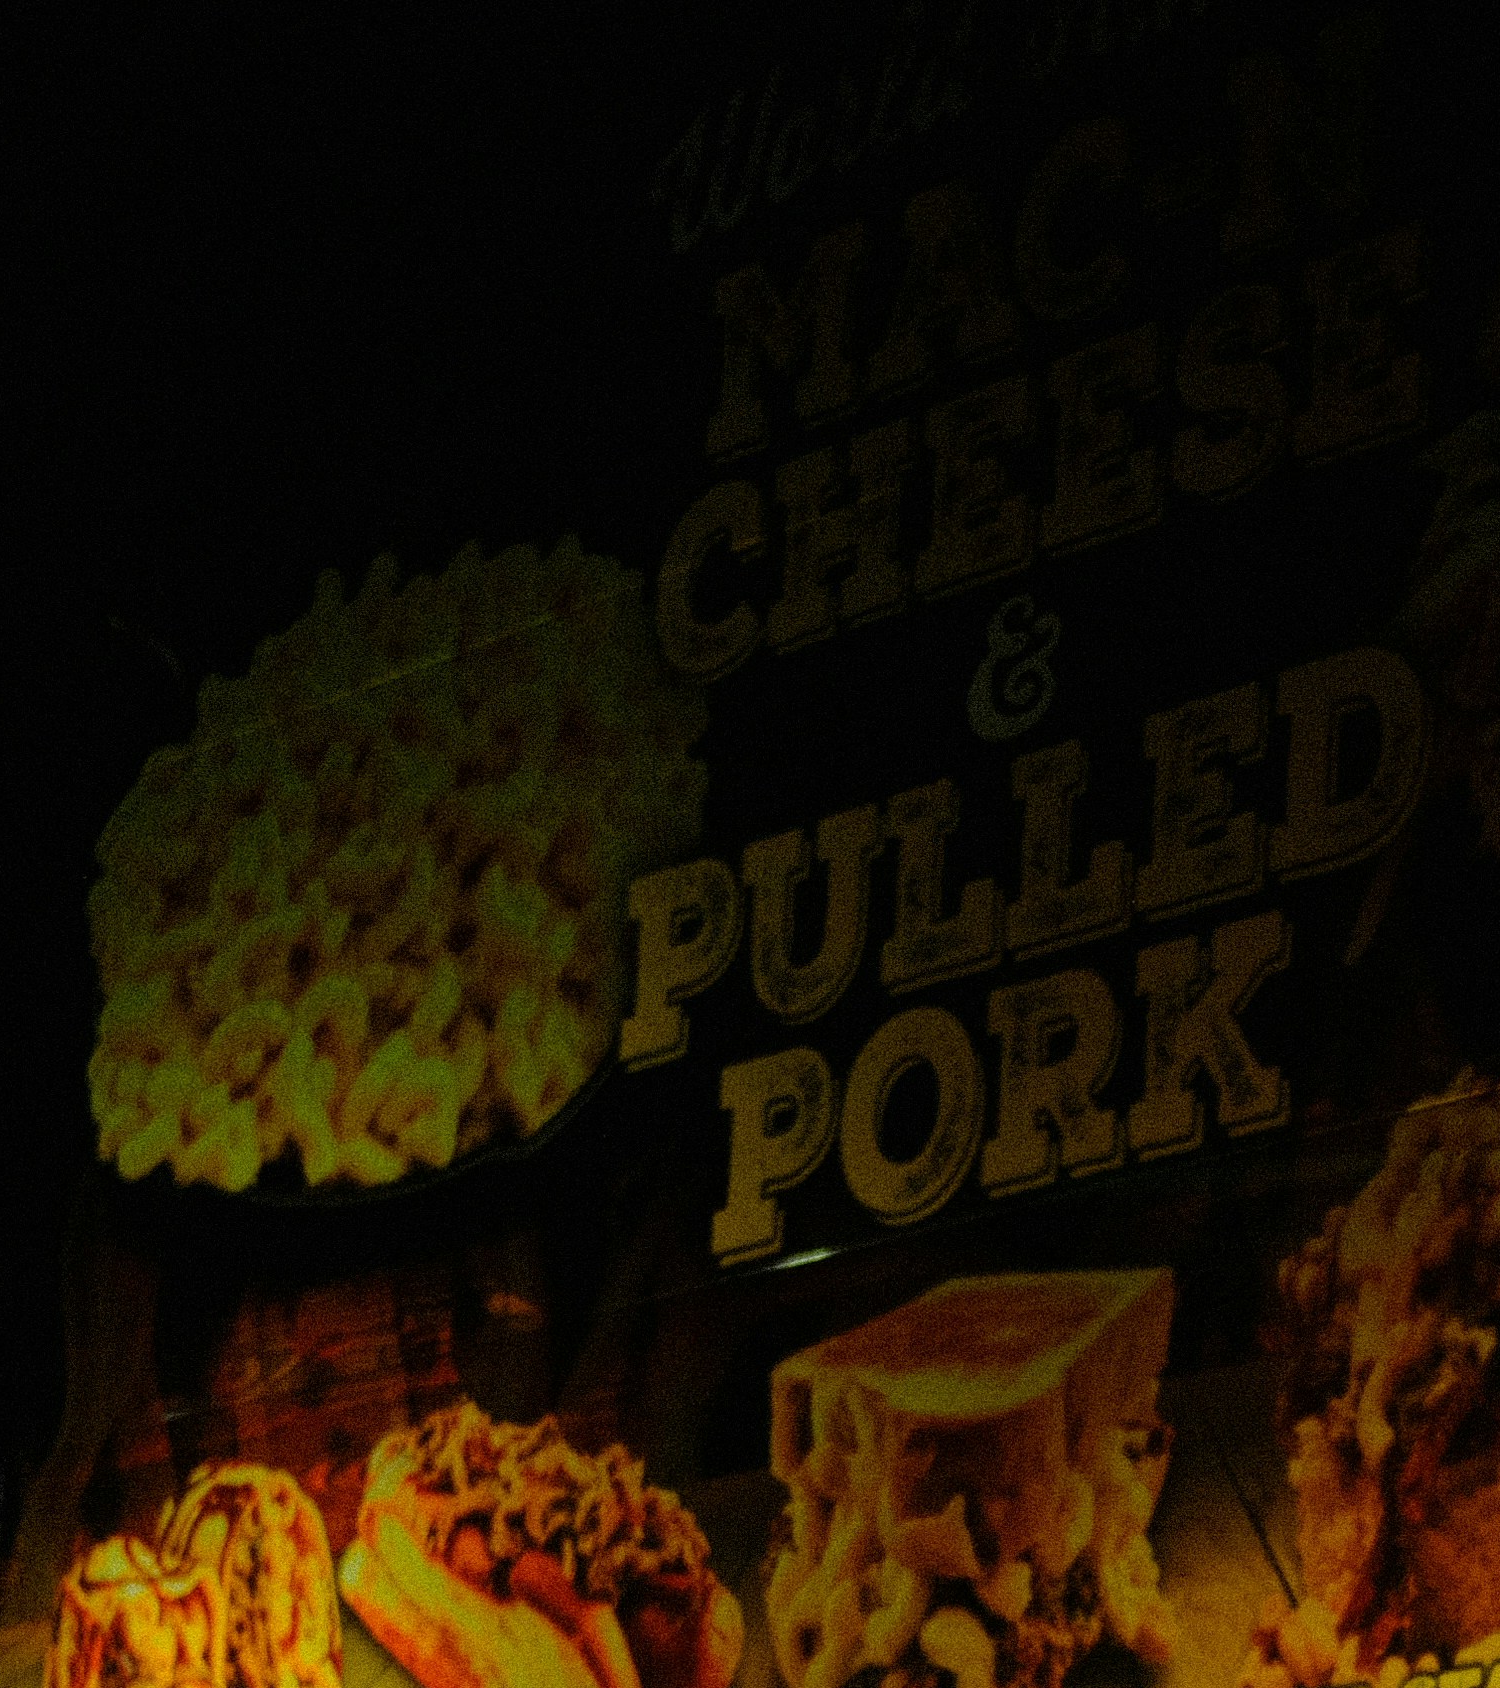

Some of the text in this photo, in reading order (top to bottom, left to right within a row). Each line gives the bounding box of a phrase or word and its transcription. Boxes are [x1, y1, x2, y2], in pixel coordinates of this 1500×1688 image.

[657, 222, 1428, 684] CHEESE
[616, 645, 1434, 1074] PULLED
[966, 595, 1064, 743] &
[710, 910, 1293, 1268] PORK
